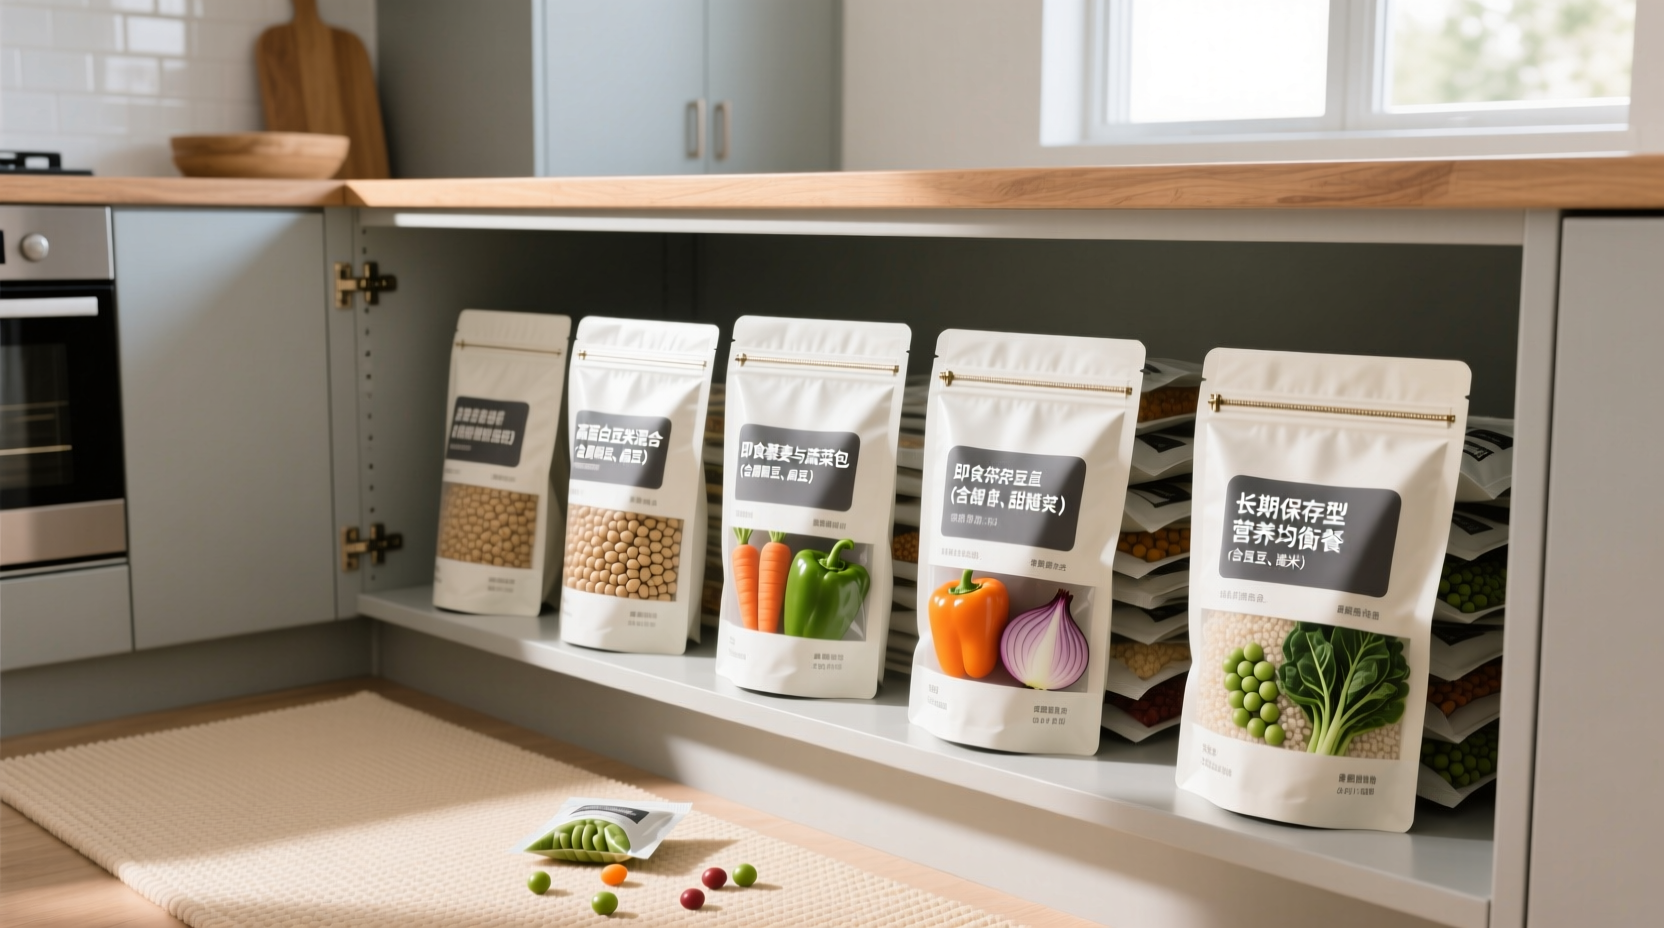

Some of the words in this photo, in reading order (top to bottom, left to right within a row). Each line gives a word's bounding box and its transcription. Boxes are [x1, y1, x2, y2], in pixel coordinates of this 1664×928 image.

[1236, 492, 1348, 526] 长期保存型
